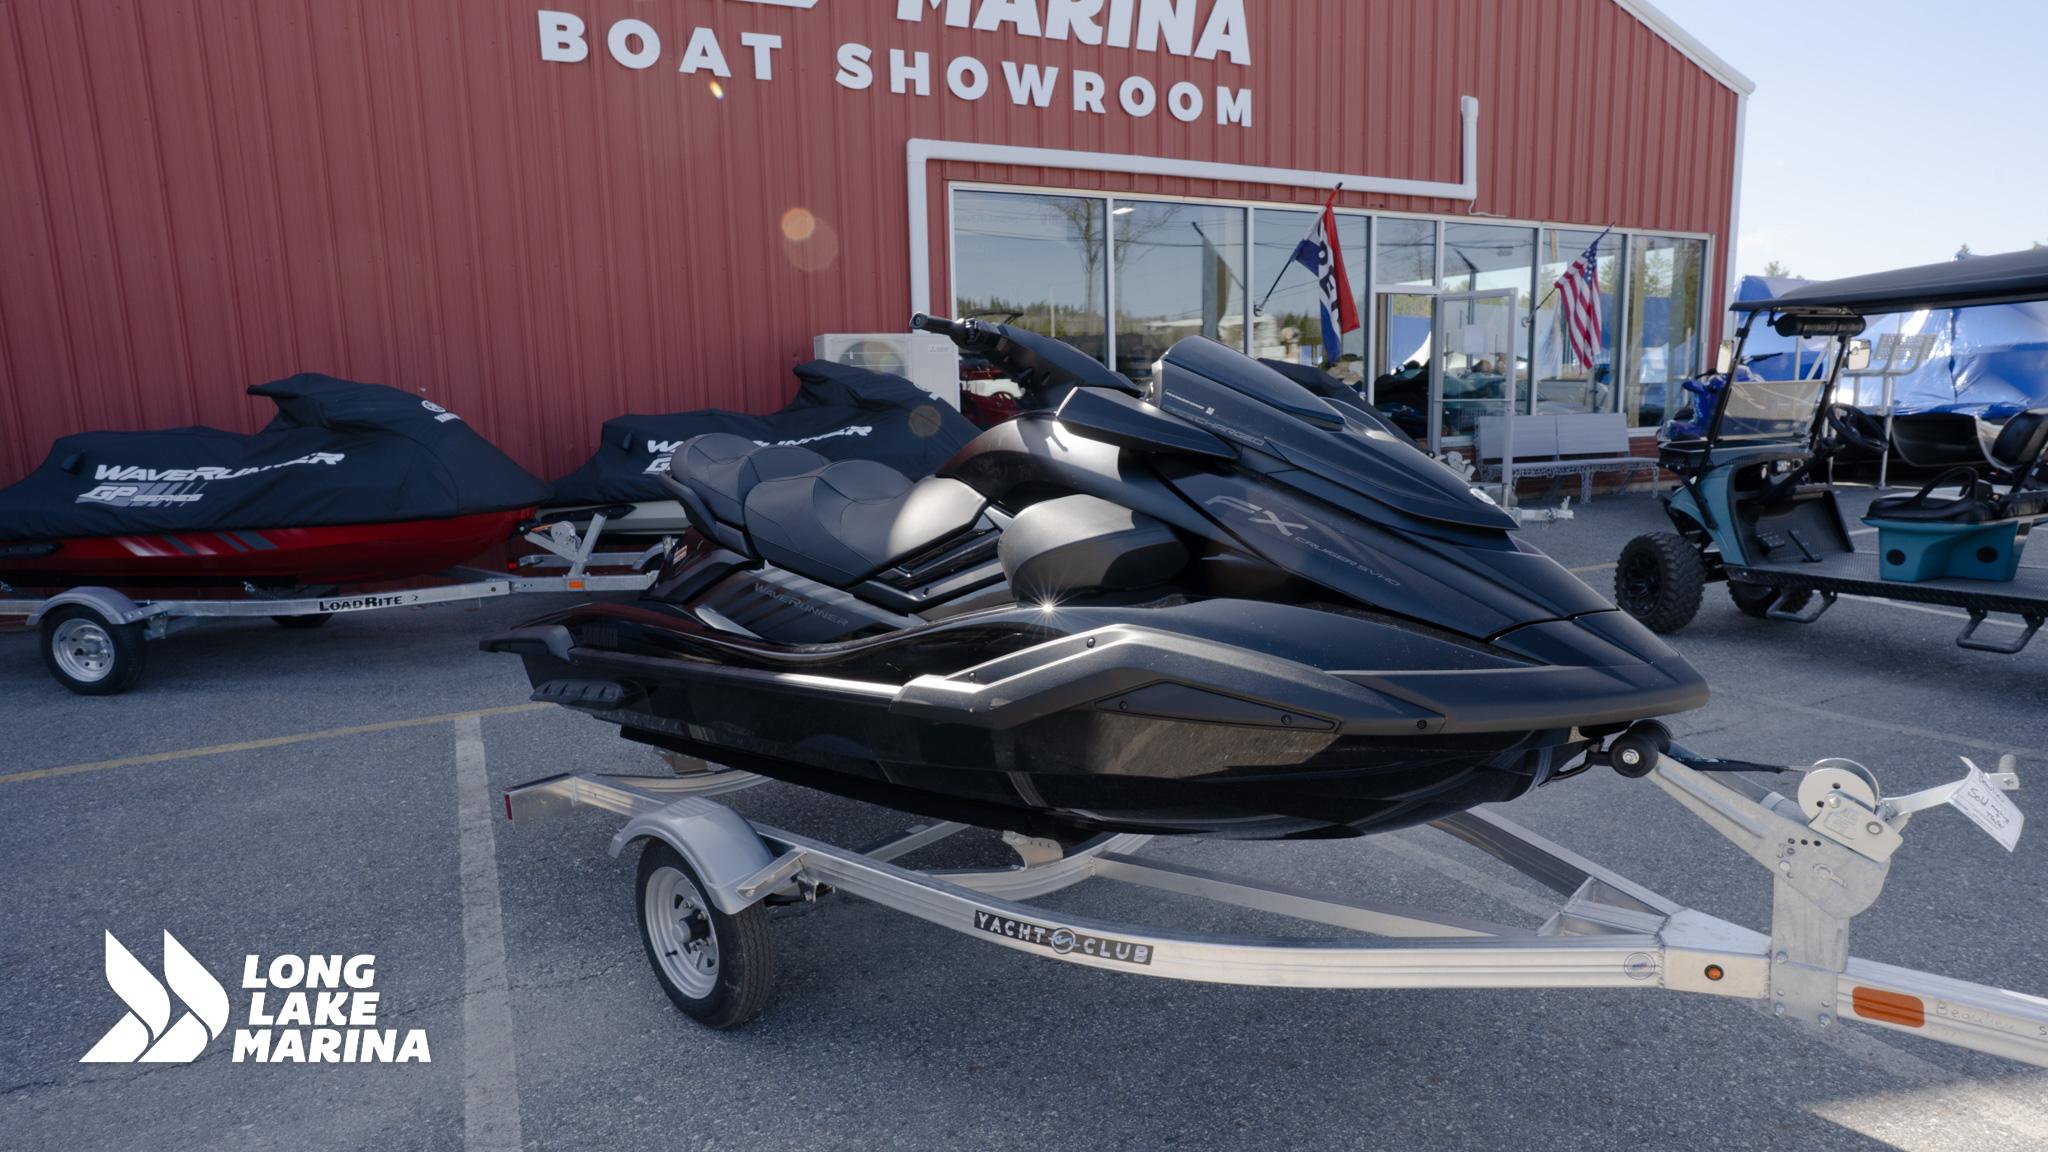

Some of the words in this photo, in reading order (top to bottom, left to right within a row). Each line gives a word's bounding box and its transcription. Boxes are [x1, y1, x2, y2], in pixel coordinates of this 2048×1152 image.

[896, 0, 1252, 66] ARINA
[538, 9, 783, 81] BOAT
[835, 42, 1253, 128] SHOWROOM
[1205, 495, 1309, 537] FX
[1295, 536, 1357, 567] CRUISER
[1357, 564, 1400, 586] SVHO
[978, 912, 1046, 944] YACHT
[1083, 938, 1149, 963] CLUB
